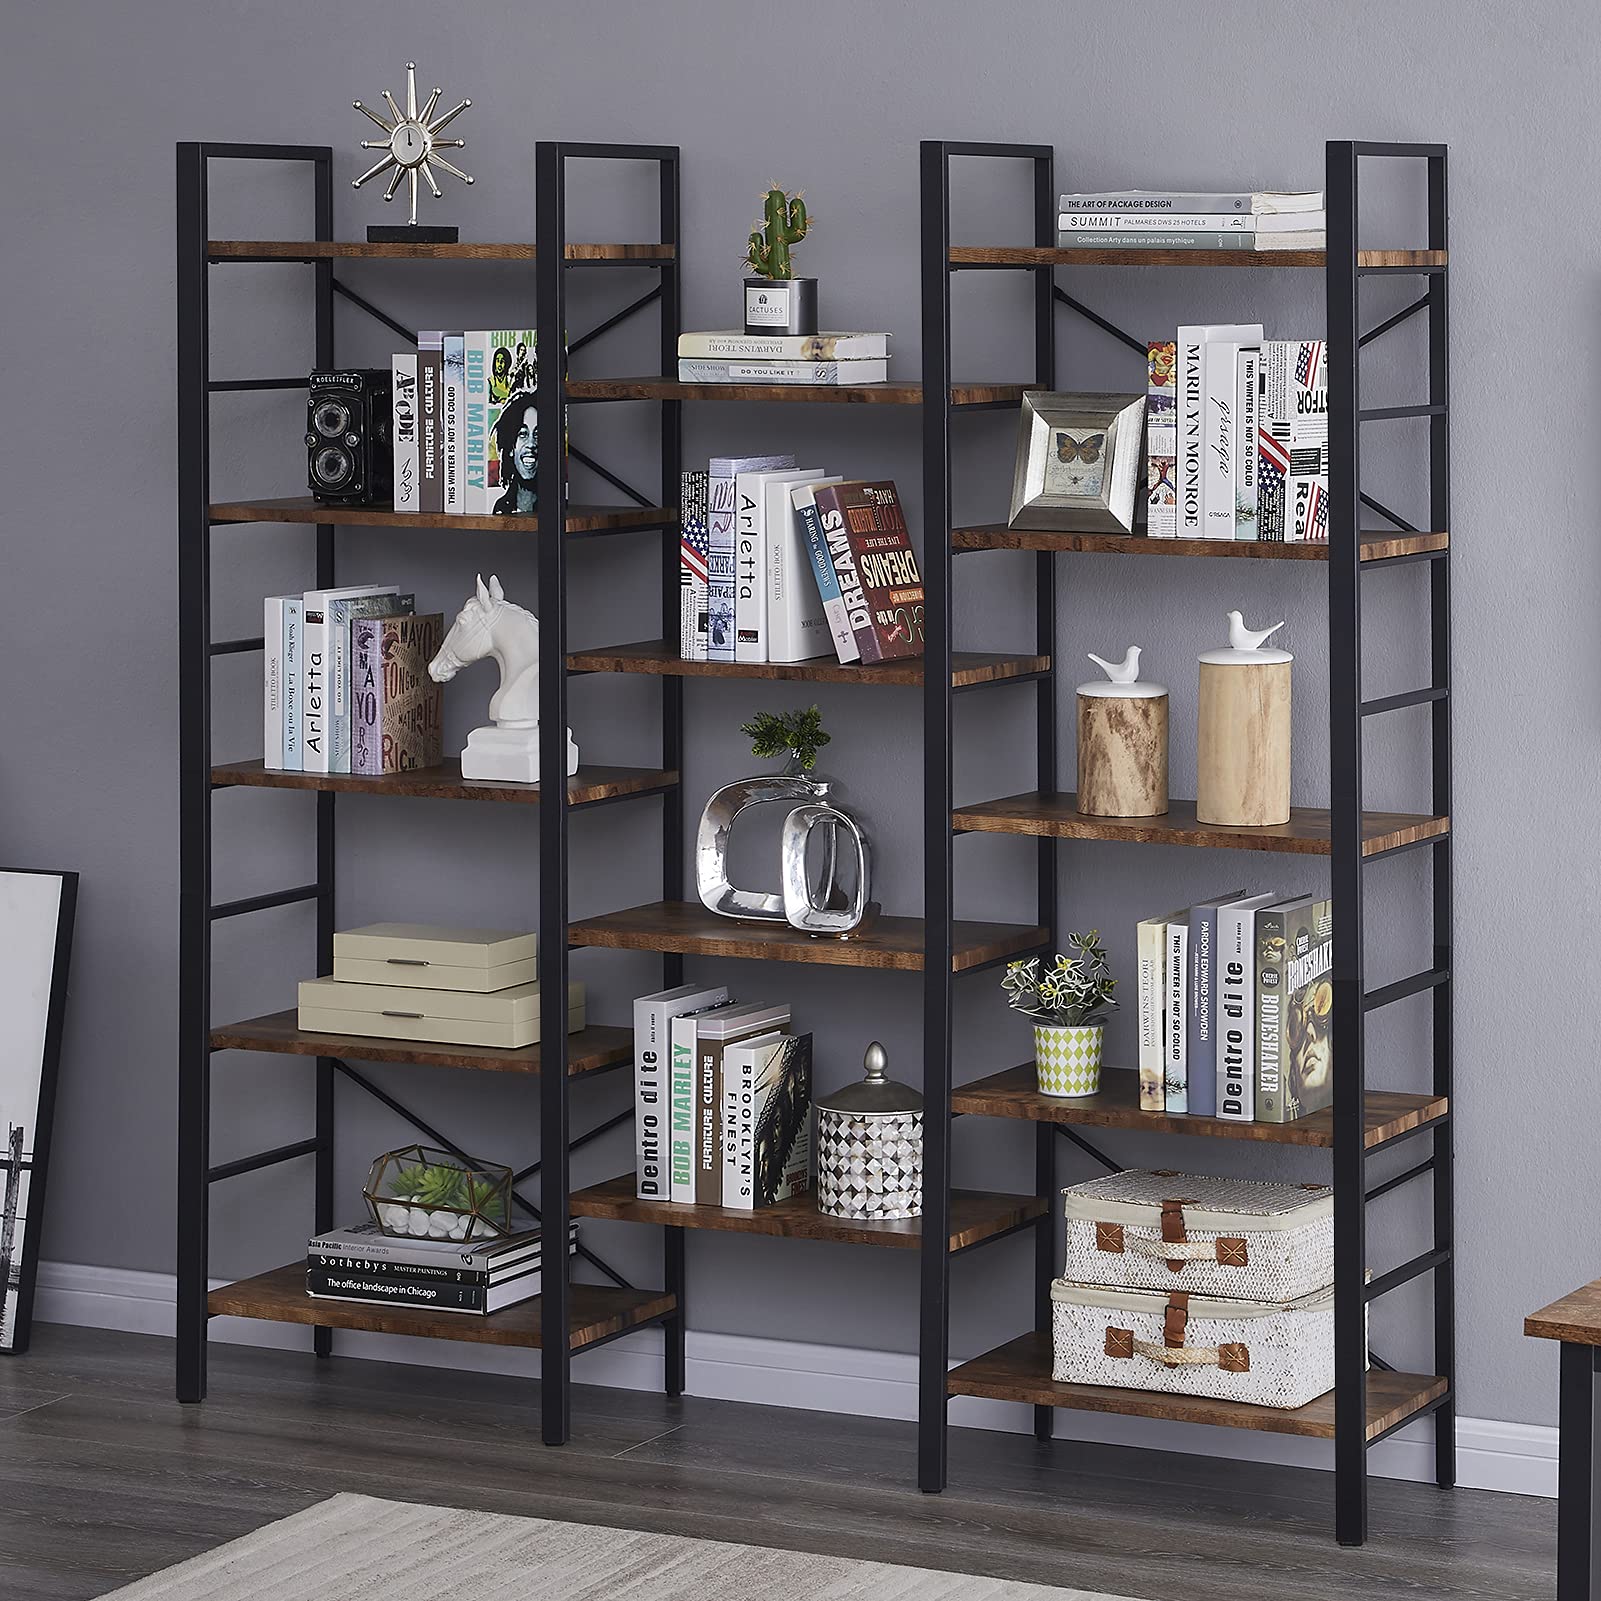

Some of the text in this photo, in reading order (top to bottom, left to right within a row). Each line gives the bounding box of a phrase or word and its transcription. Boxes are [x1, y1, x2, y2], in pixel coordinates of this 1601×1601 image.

[1068, 200, 1172, 208] THE ART OF PACKAGE DESIGN
[1070, 216, 1121, 227] SUMMIT
[708, 344, 783, 353] DARWINS TEORI
[749, 306, 783, 314] CACTUSES
[447, 386, 456, 505] THIS WINTER IS NOT SO COLOD
[467, 350, 484, 490] BOB MARLEY
[1244, 359, 1254, 487] THIS WINTER IS NOT SO COLOD
[1184, 441, 1199, 527] MONROE
[740, 493, 758, 599] Arletta
[821, 510, 872, 631] DREAMS
[860, 550, 921, 589] DREAMS
[287, 737, 295, 752] Vie
[305, 652, 322, 754] Arletta
[1142, 995, 1150, 1047] DARWINS
[1172, 934, 1181, 1061] THIS WINTER IS NOT SO COLOD
[1200, 921, 1209, 1041] PARDON EDWARD SNOWDEN
[1222, 962, 1243, 1115] Dentro di te
[1260, 993, 1279, 1092] BONESHAKER
[640, 1050, 659, 1195] Dentro di te
[673, 1043, 691, 1185] BOB MARLEY
[727, 1092, 738, 1166] FINEST
[740, 1065, 752, 1196] BROOKLYN'S
[322, 1241, 342, 1250] Pacific
[366, 1246, 389, 1255] Awards
[327, 1277, 437, 1299] The office landscape in Chicago
[393, 1265, 448, 1276] MASTER PAINTINGS
